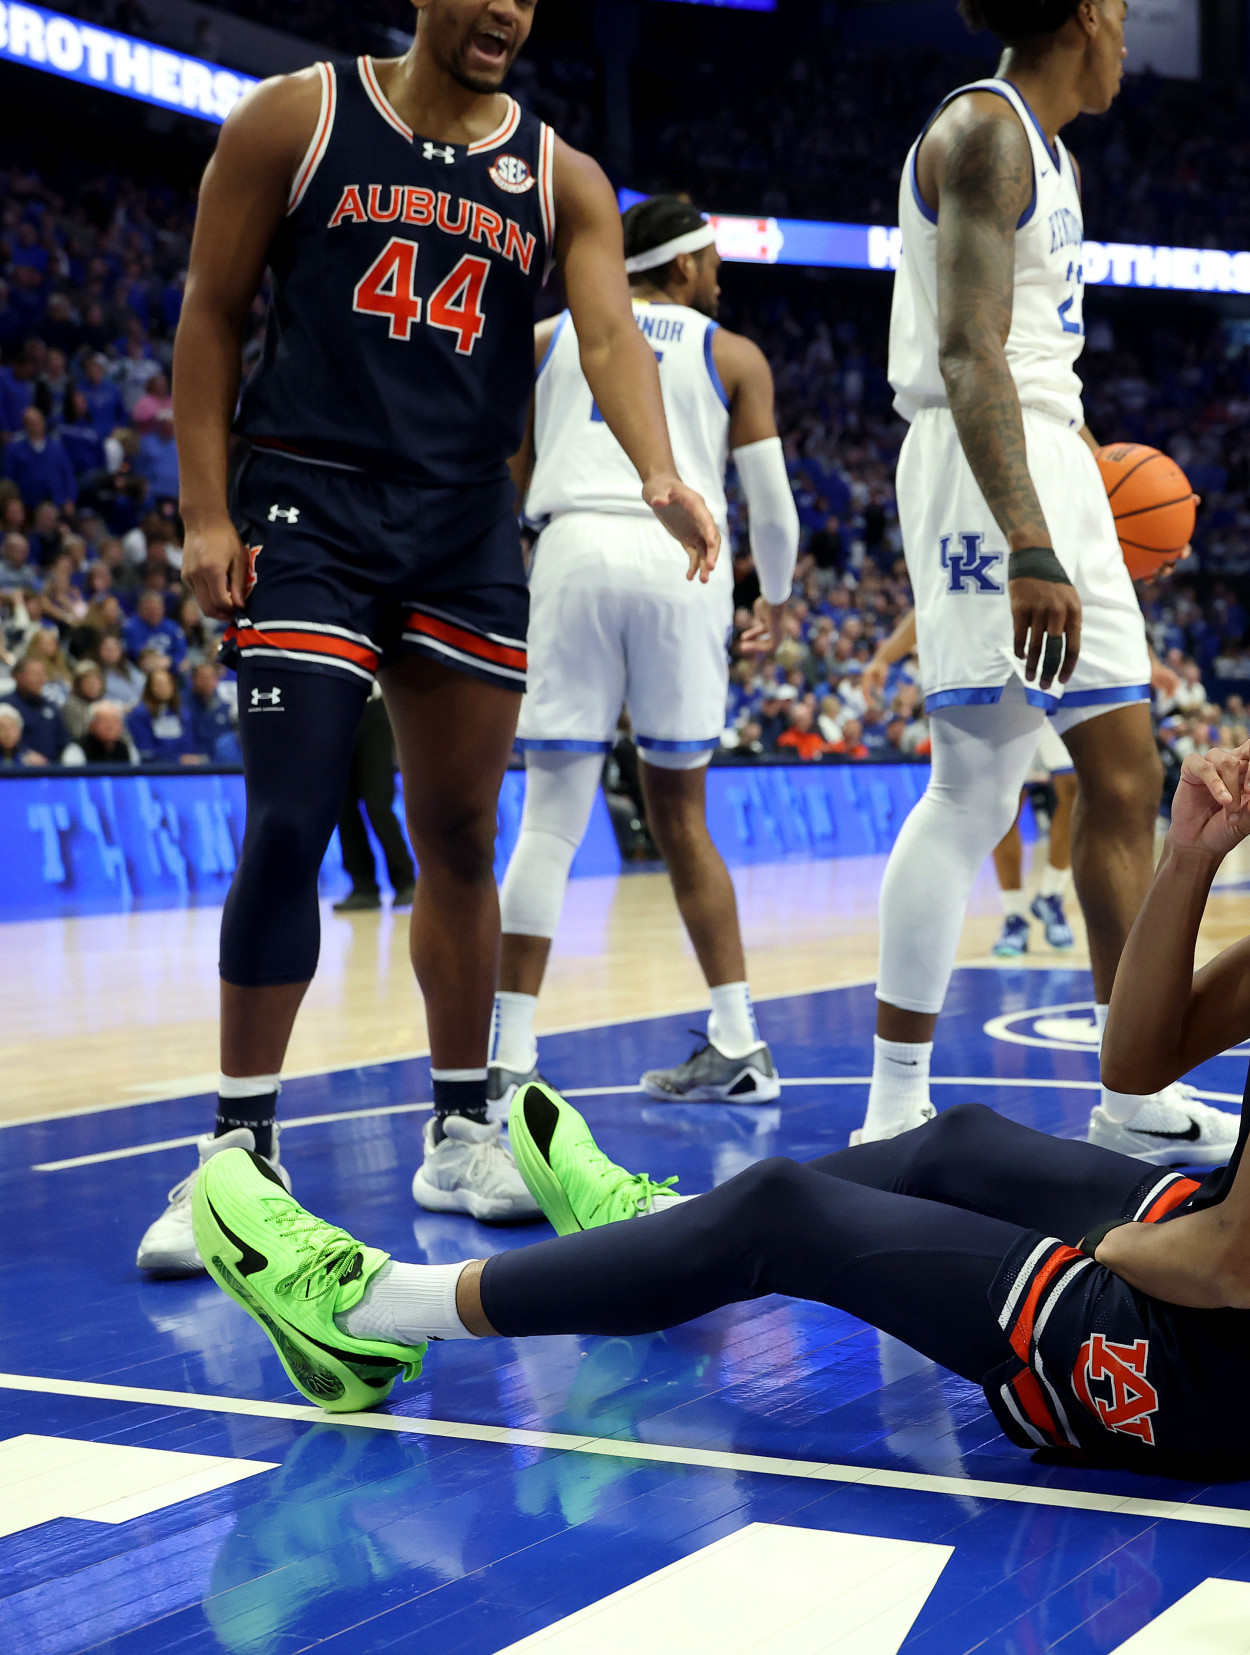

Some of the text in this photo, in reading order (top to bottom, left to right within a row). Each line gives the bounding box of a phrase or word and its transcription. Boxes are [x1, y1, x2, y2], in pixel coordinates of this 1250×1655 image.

[0, 2, 259, 121] ROTHERS
[497, 155, 528, 184] SEC
[327, 184, 537, 276] AUBURN
[352, 236, 491, 356] 44
[939, 531, 1005, 595] UK
